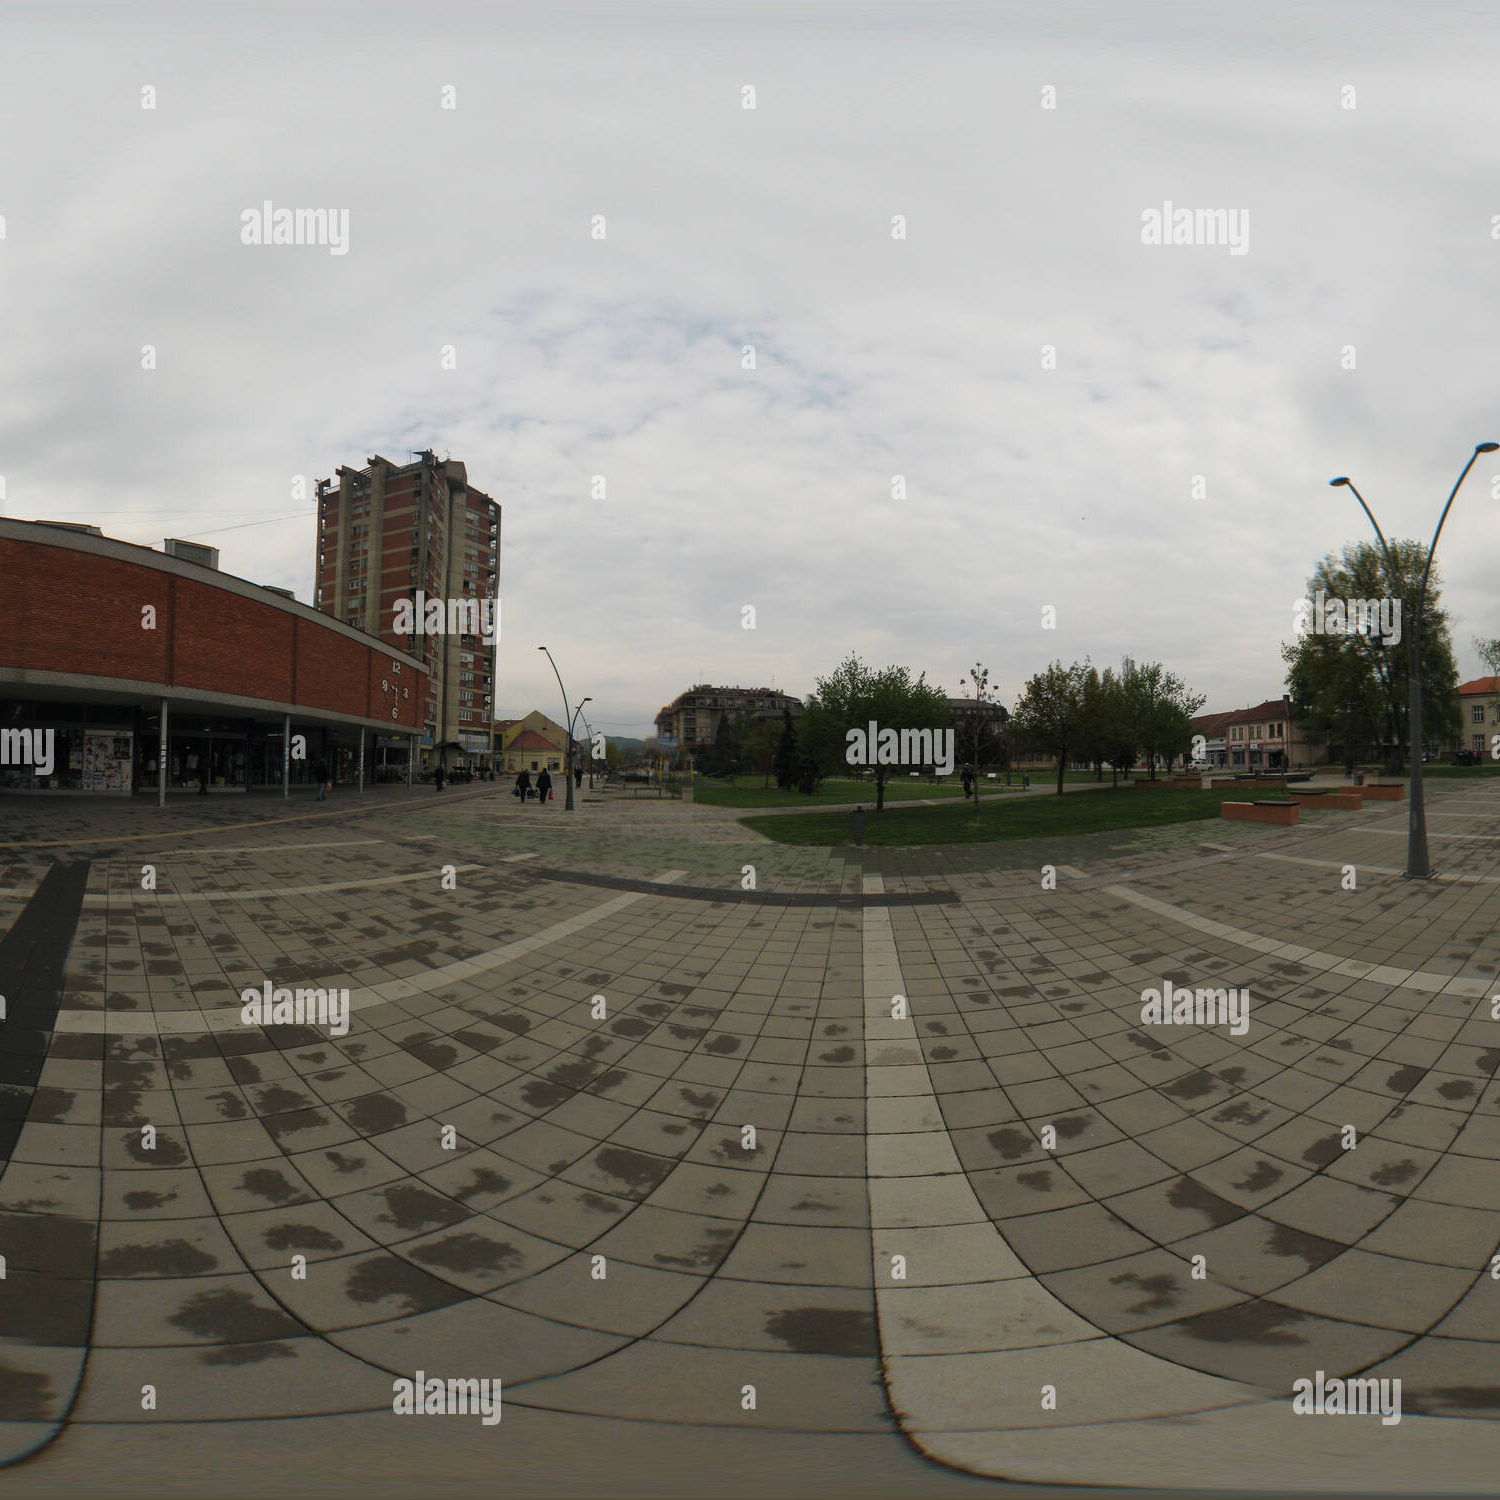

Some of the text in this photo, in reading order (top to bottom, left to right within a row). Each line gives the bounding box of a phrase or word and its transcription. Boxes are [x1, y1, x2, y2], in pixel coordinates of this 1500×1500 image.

[392, 661, 400, 674] 12
[381, 679, 388, 692] 9
[402, 687, 409, 699] 3
[392, 707, 398, 719] 6
